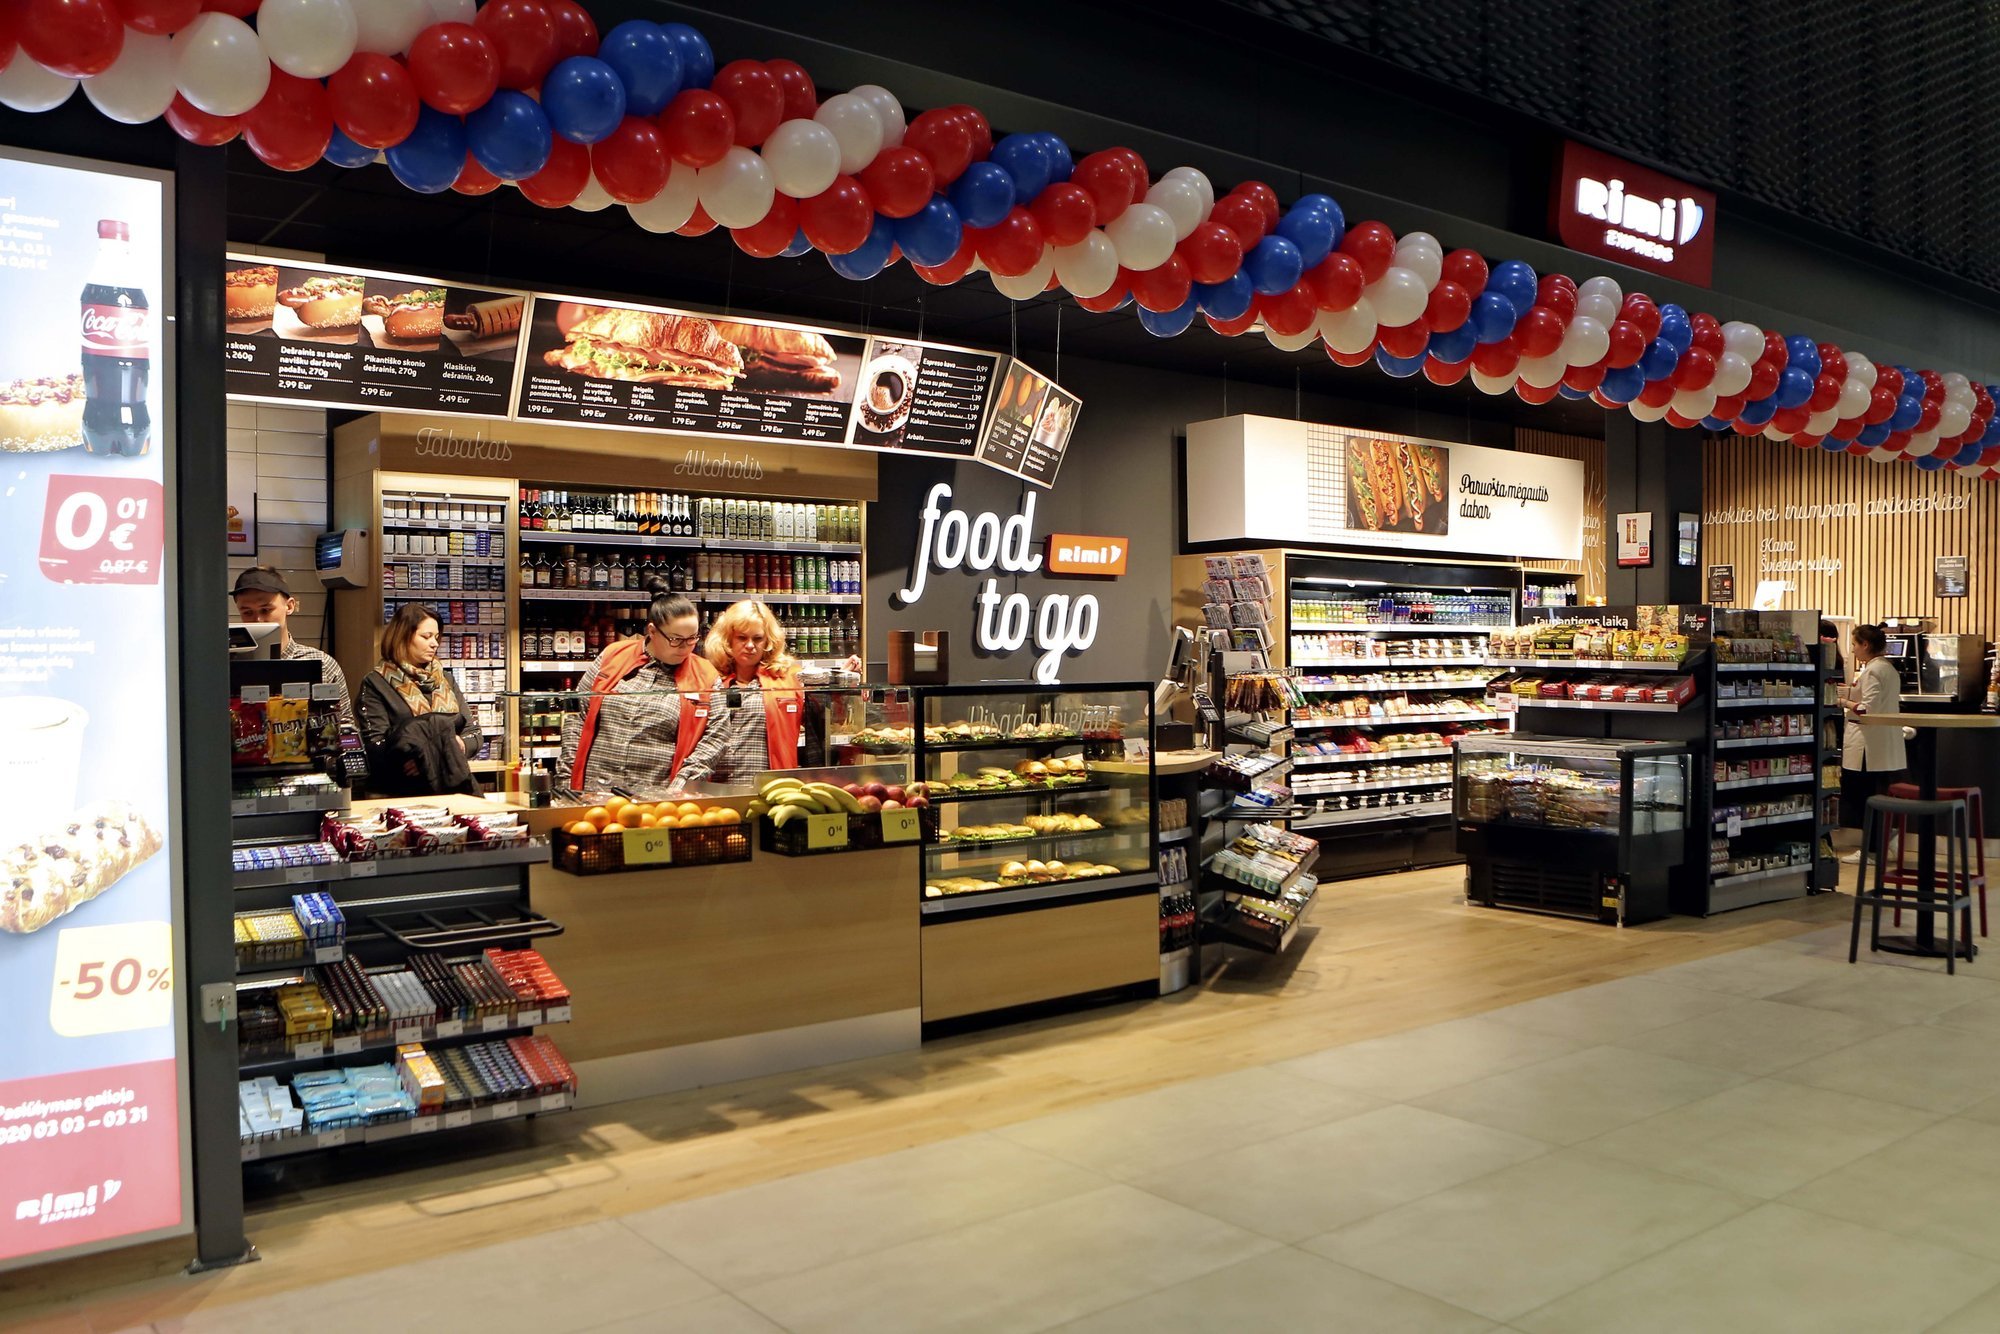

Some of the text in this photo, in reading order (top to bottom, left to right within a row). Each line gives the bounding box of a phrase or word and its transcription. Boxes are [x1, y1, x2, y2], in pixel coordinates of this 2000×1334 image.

[1577, 177, 1677, 241] Rimi
[402, 358, 426, 368] skonio
[443, 361, 477, 372] Klasikinis
[308, 367, 329, 378] 270g
[398, 367, 417, 378] 270g
[475, 373, 494, 384] 260g
[278, 379, 313, 391] 2,99 Eur
[360, 387, 394, 397] 2,99 Eur
[438, 394, 471, 404] 2,49 Eur
[527, 404, 554, 413] 1,99 Eur
[580, 409, 607, 418] 1,99 Eur
[627, 413, 656, 422] 2,49 Eur
[684, 418, 697, 426] Eur
[716, 421, 742, 430] 2,99 Eur
[772, 426, 784, 434] Eur
[815, 430, 827, 438] Eur
[415, 426, 513, 462] Tabakas
[674, 449, 763, 481] Alkoholis
[1459, 473, 1549, 508] Paruošta mėgautis
[1459, 498, 1491, 520] dabar
[1756, 503, 1779, 522] bei
[1785, 500, 1860, 525] trumpam
[55, 491, 108, 551] 0
[108, 523, 137, 551] €
[900, 482, 1043, 603] food
[1682, 613, 1698, 625] food
[977, 577, 1099, 685] to go
[34, 1119, 59, 1139] 03
[61, 1115, 85, 1134] 03
[103, 1109, 127, 1128] 03
[129, 1106, 148, 1124] 31
